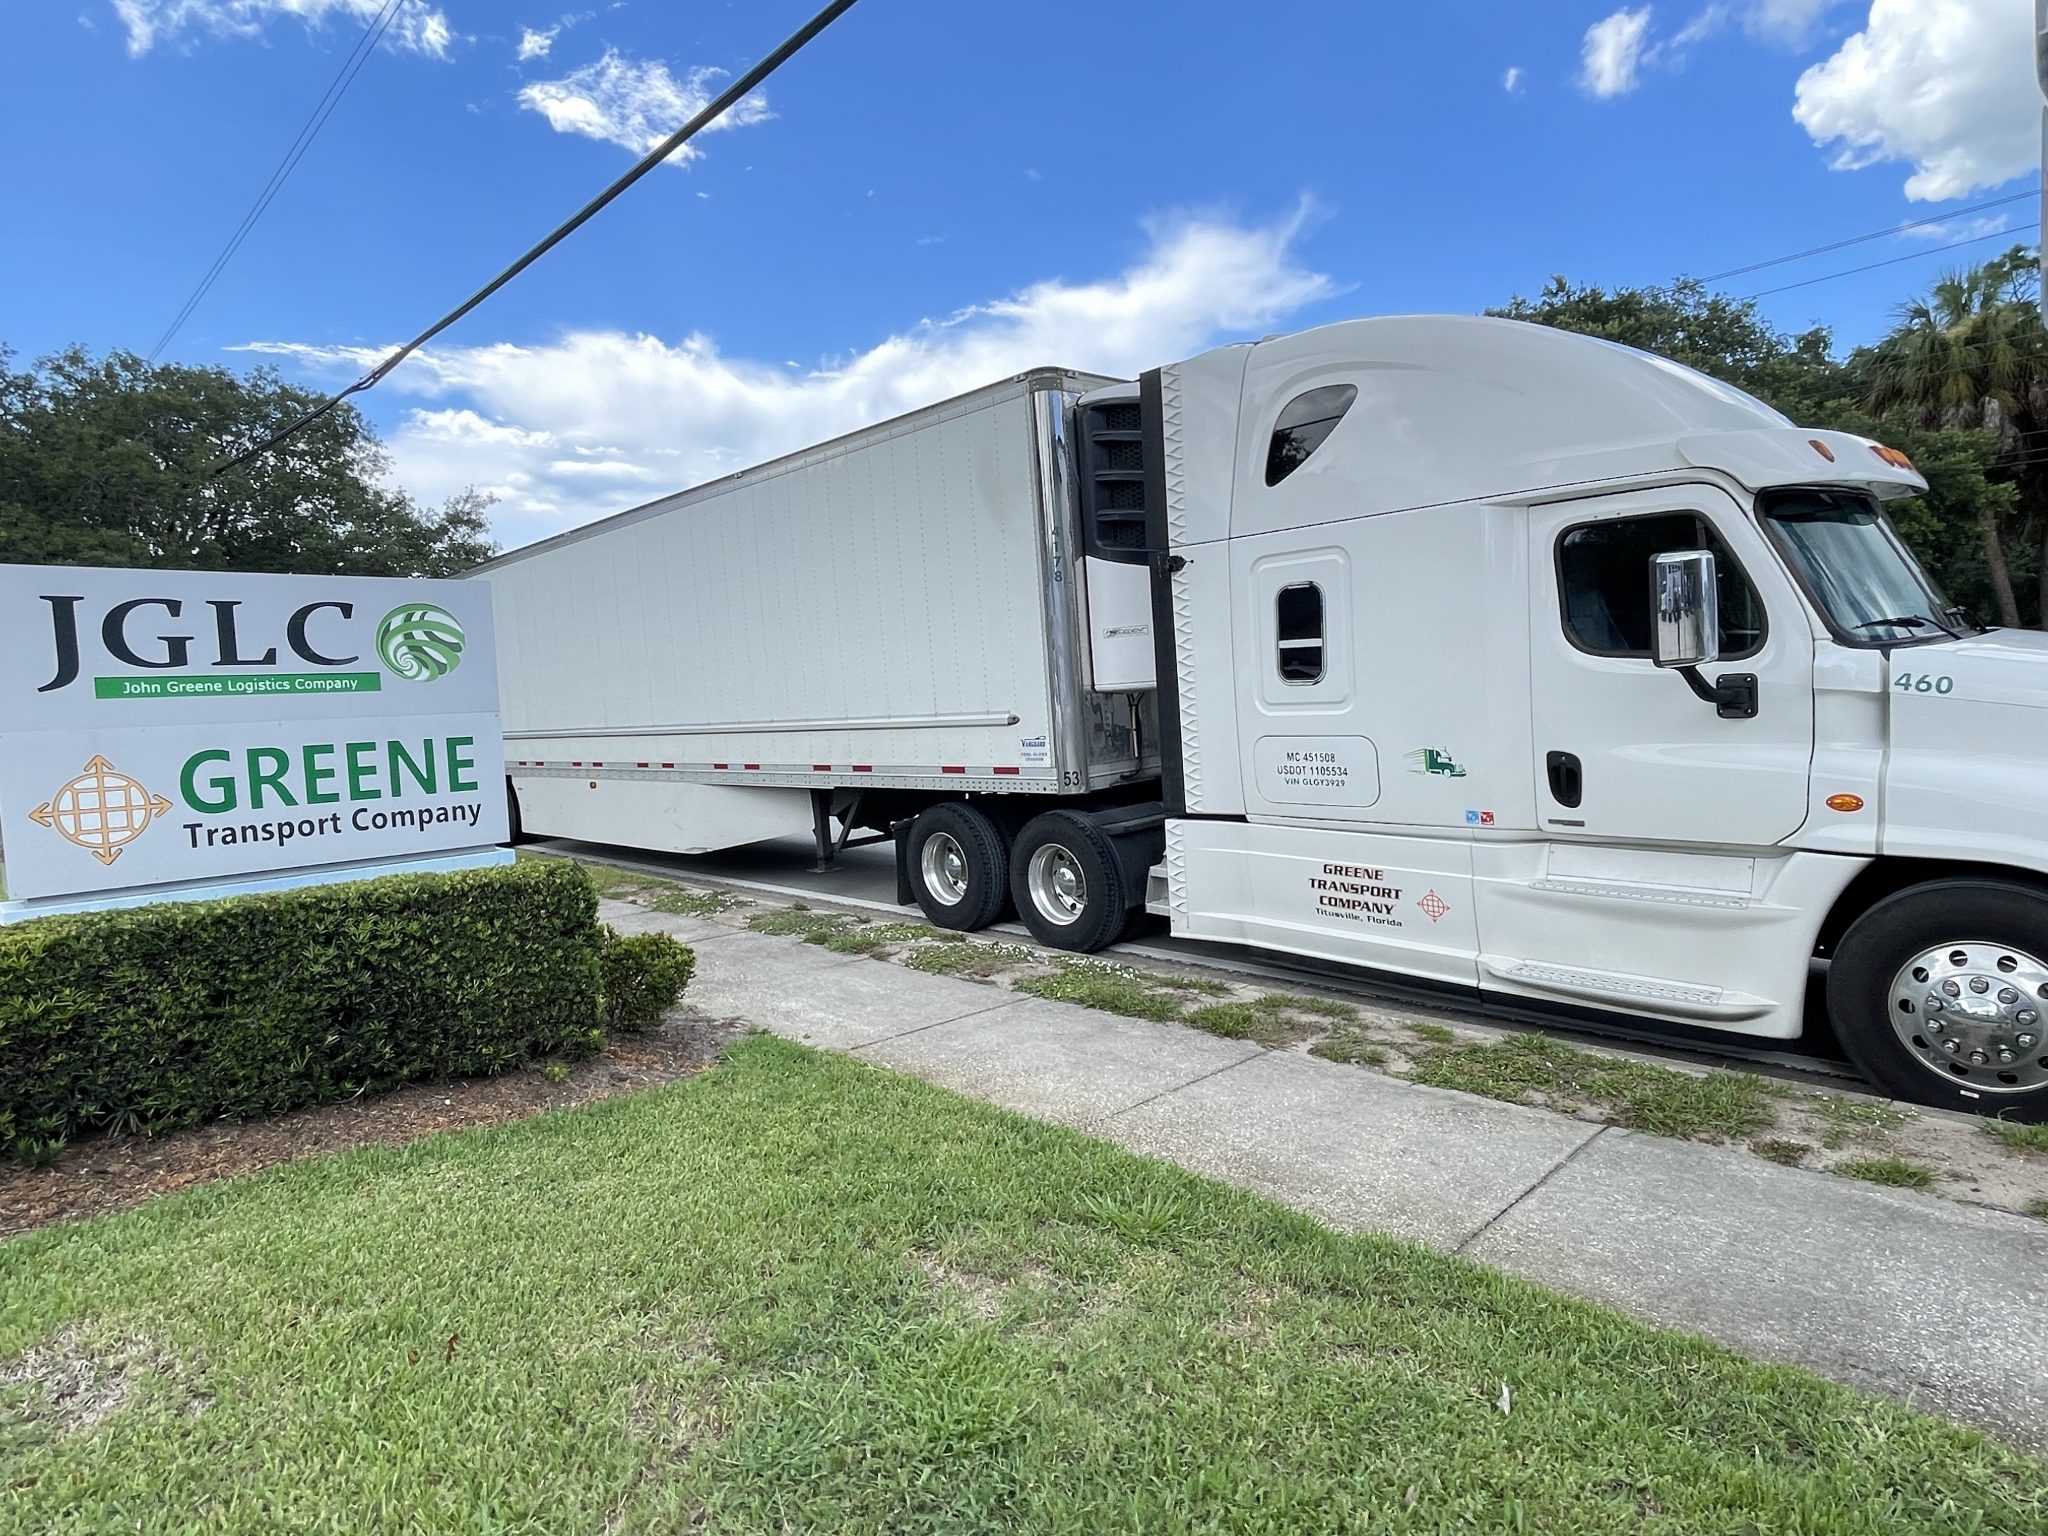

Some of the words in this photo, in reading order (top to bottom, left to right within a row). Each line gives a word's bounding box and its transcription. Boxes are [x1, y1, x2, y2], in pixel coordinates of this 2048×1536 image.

[37, 595, 359, 693] JGLC
[123, 681, 161, 694] John
[166, 680, 223, 693] Greene
[228, 677, 290, 693] Logistics
[295, 677, 358, 691] Company
[1894, 673, 1953, 694] 460
[1286, 752, 1300, 762] MC
[1303, 752, 1336, 763] 451508
[179, 736, 479, 814] GREENE
[1064, 771, 1080, 787] 53
[1277, 765, 1306, 775] USDOT
[1310, 766, 1348, 776] 1105534
[1302, 778, 1346, 787] GLGY3929
[183, 812, 342, 849] Transport
[351, 802, 482, 830] Company
[1323, 863, 1384, 881] GREENE
[1308, 878, 1402, 900] TRANSPORT
[1319, 895, 1395, 915] COMPANY
[1315, 907, 1363, 922] Titusville,
[1367, 915, 1402, 927] Florida
